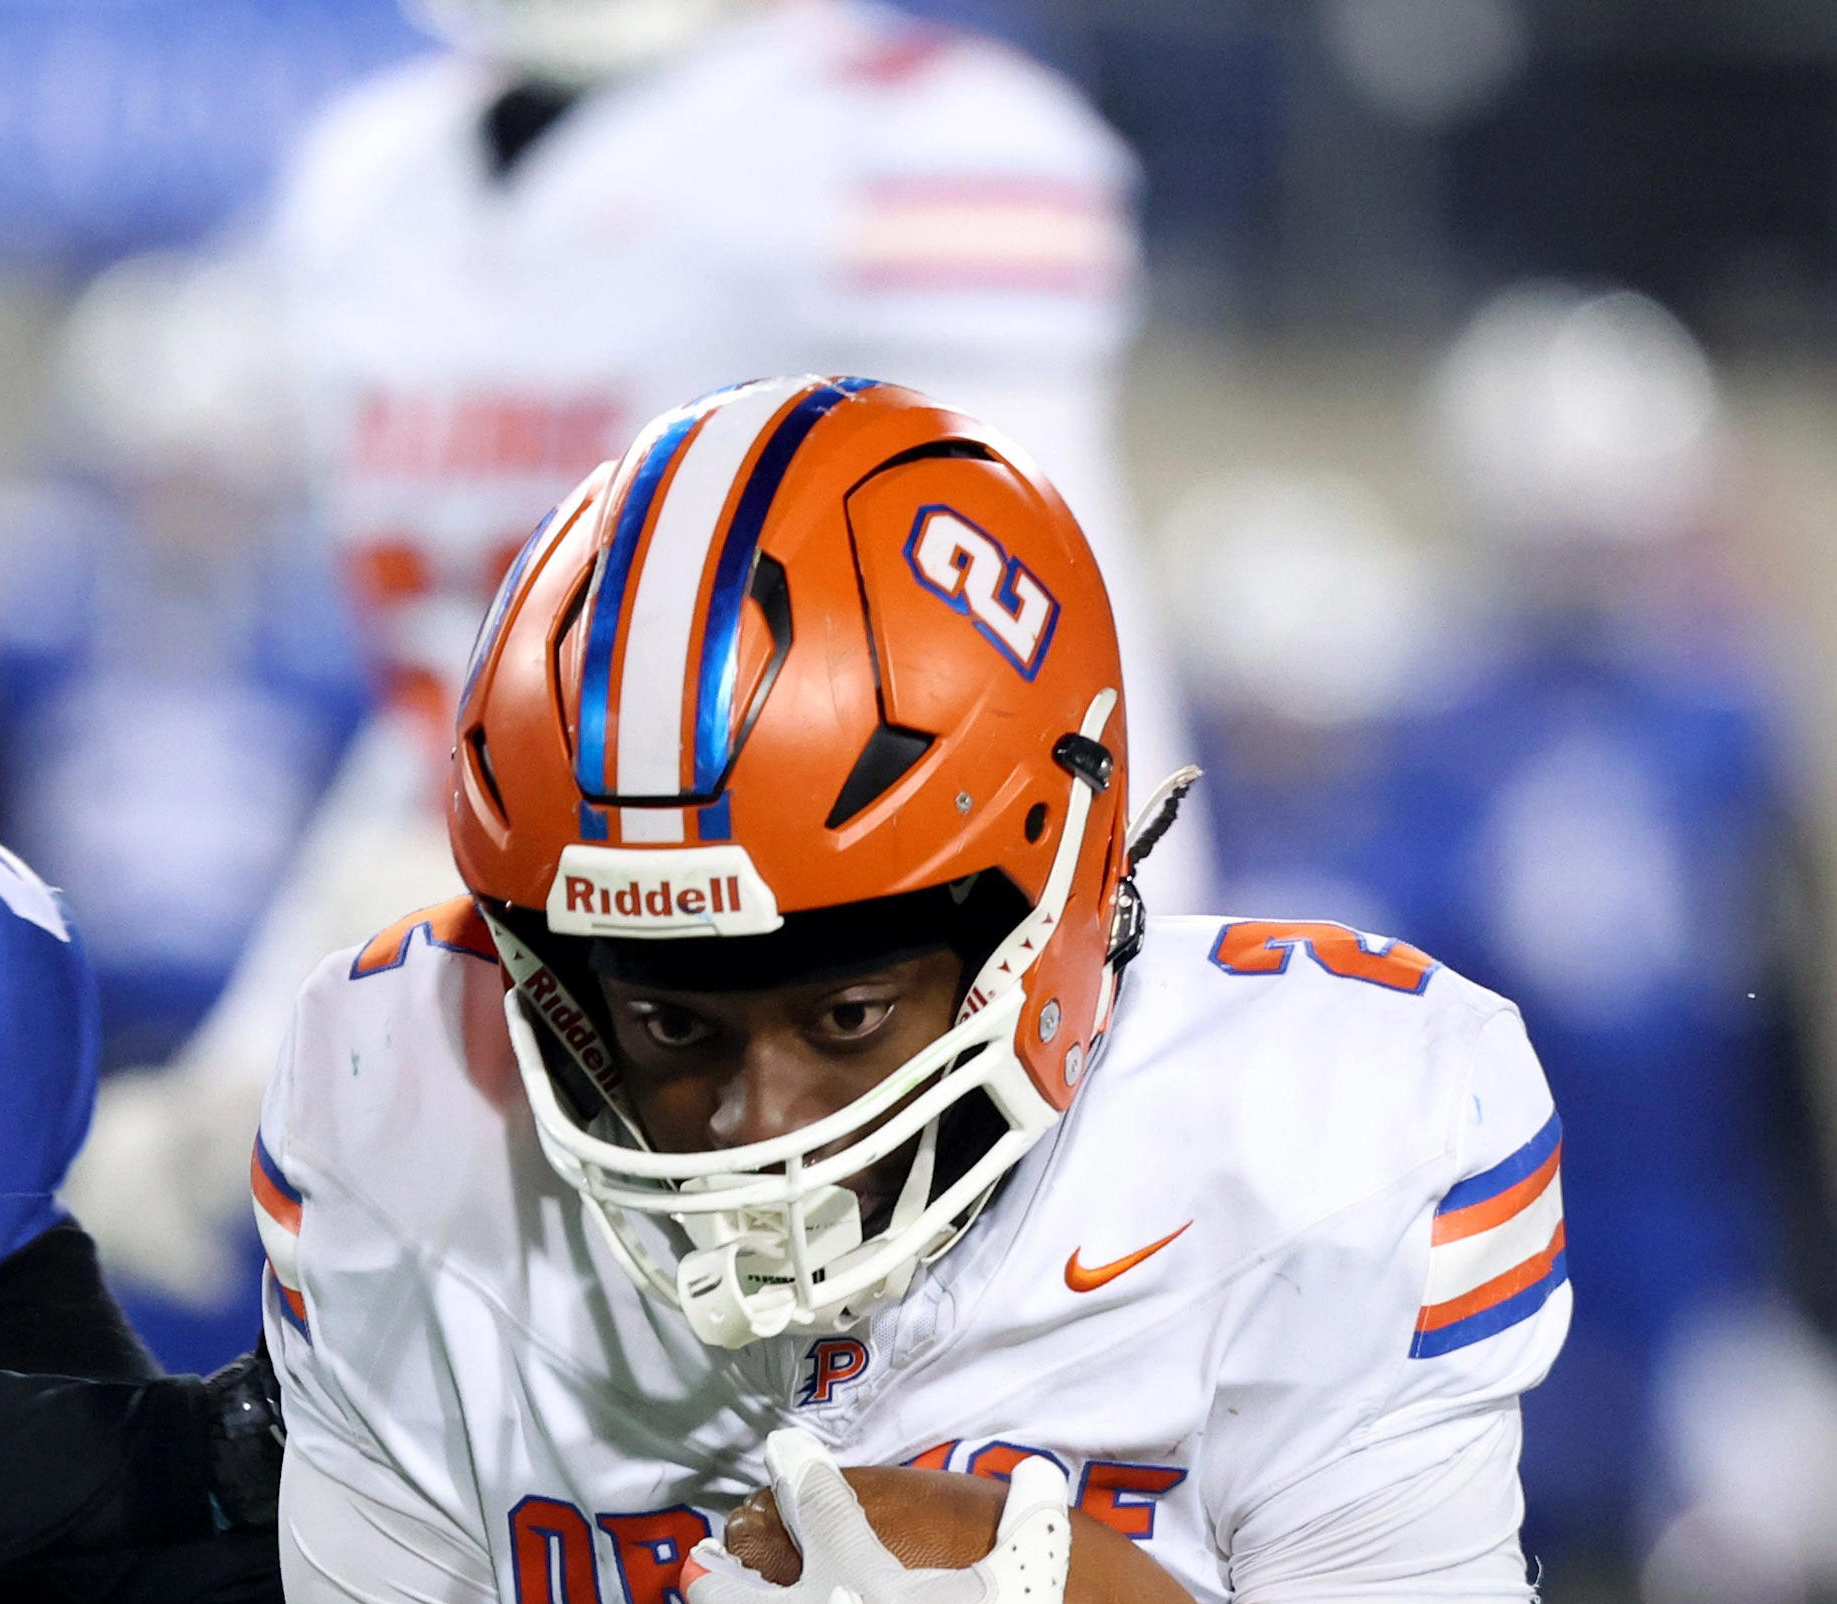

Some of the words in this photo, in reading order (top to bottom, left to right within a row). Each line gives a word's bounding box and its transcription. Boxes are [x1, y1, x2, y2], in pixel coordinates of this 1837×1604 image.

[902, 504, 1060, 682] 2
[565, 875, 741, 917] Riddell
[524, 966, 622, 1092] Riddell
[794, 1336, 869, 1408] P
